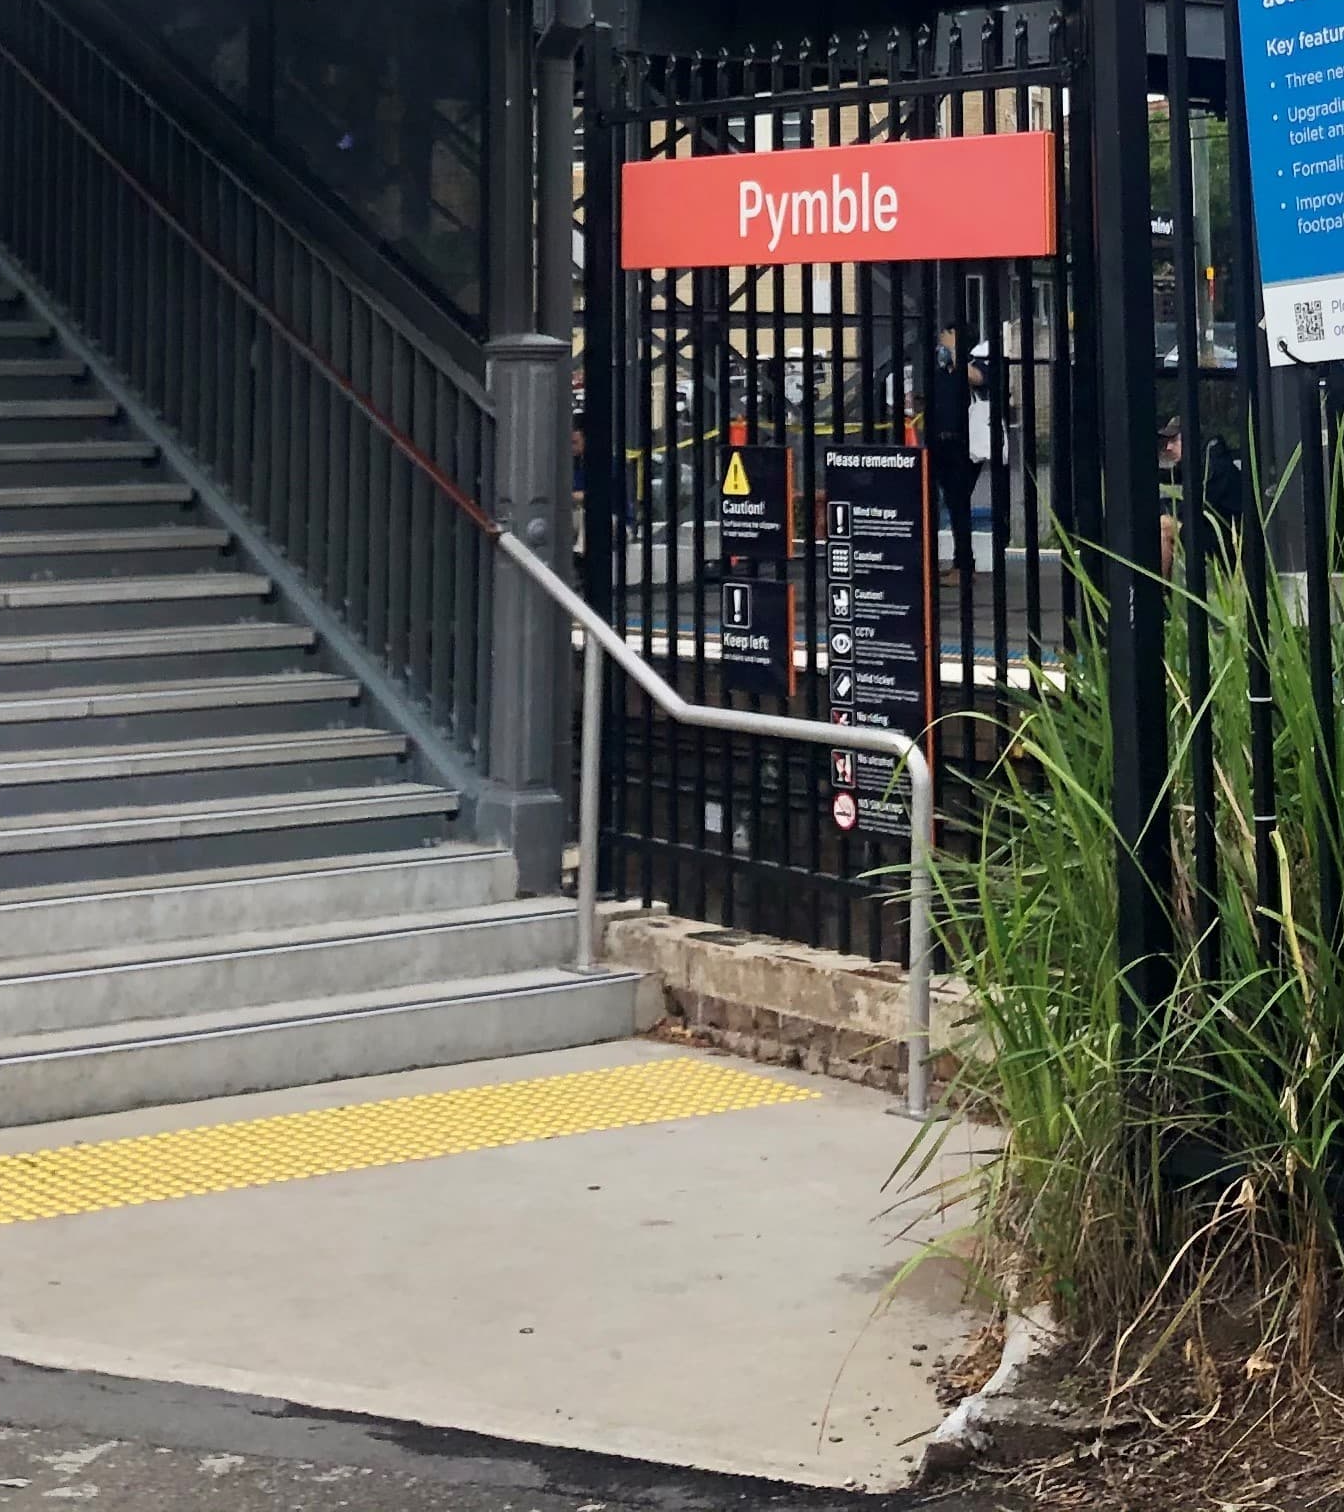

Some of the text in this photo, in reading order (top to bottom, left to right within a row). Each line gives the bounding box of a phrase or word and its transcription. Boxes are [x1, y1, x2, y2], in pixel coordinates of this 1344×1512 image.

[1266, 37, 1295, 57] Key
[1285, 70, 1323, 89] Three
[1289, 126, 1324, 146] toilet
[738, 171, 899, 252] Pymble
[826, 451, 916, 468] Please remember
[723, 632, 769, 651] Keep left
